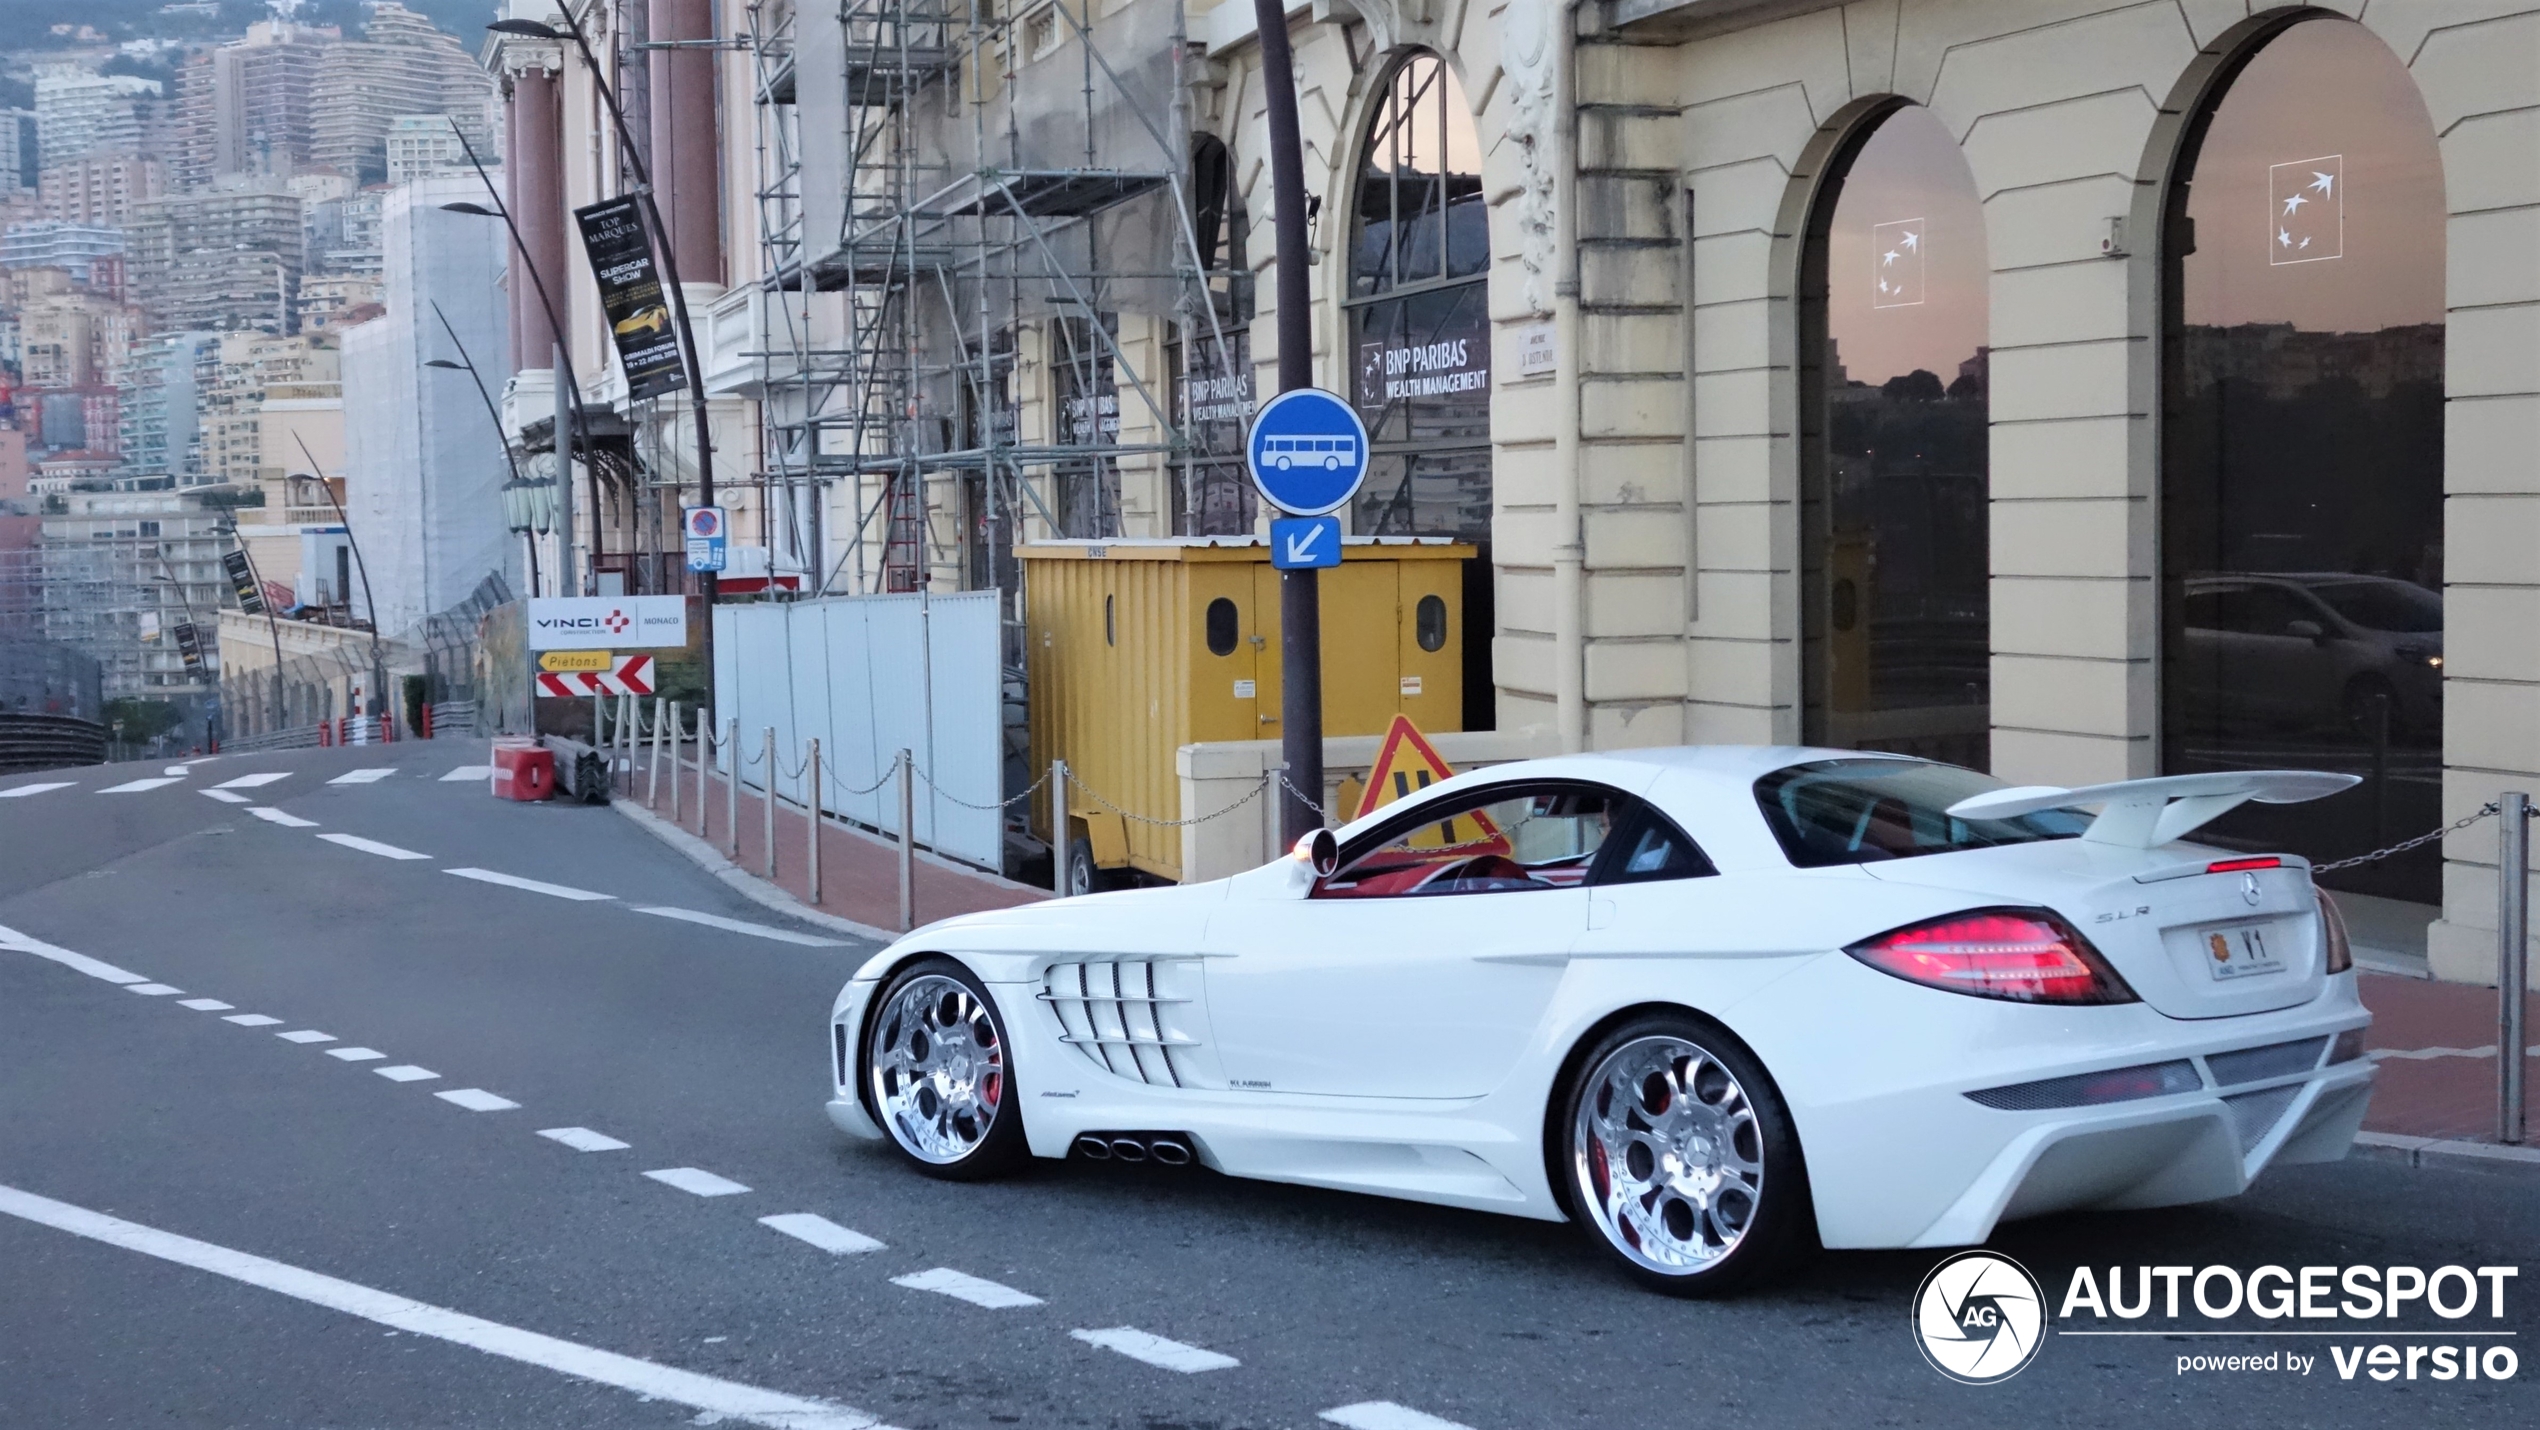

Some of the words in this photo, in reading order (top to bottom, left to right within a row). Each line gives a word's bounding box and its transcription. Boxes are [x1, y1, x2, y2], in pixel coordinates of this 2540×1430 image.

[600, 216, 620, 230] TOP
[588, 222, 638, 244] MARQUES
[600, 258, 650, 279] SUPERCAR
[612, 269, 641, 285] SHOW
[623, 345, 655, 361] GRIMALDI
[655, 341, 676, 354] FORUM
[638, 356, 647, 366] 22
[647, 353, 664, 364] APRIL
[1386, 349, 1411, 375] BNP
[1413, 338, 1468, 373] PARIBAS
[1192, 380, 1210, 402] BNP
[1386, 377, 1421, 398] WEALTH
[1422, 370, 1487, 395] MANAGEMENT
[537, 618, 599, 628] VINCI
[644, 617, 679, 625] MONACO
[549, 655, 598, 667] Piétons
[2094, 905, 2151, 924] SLR
